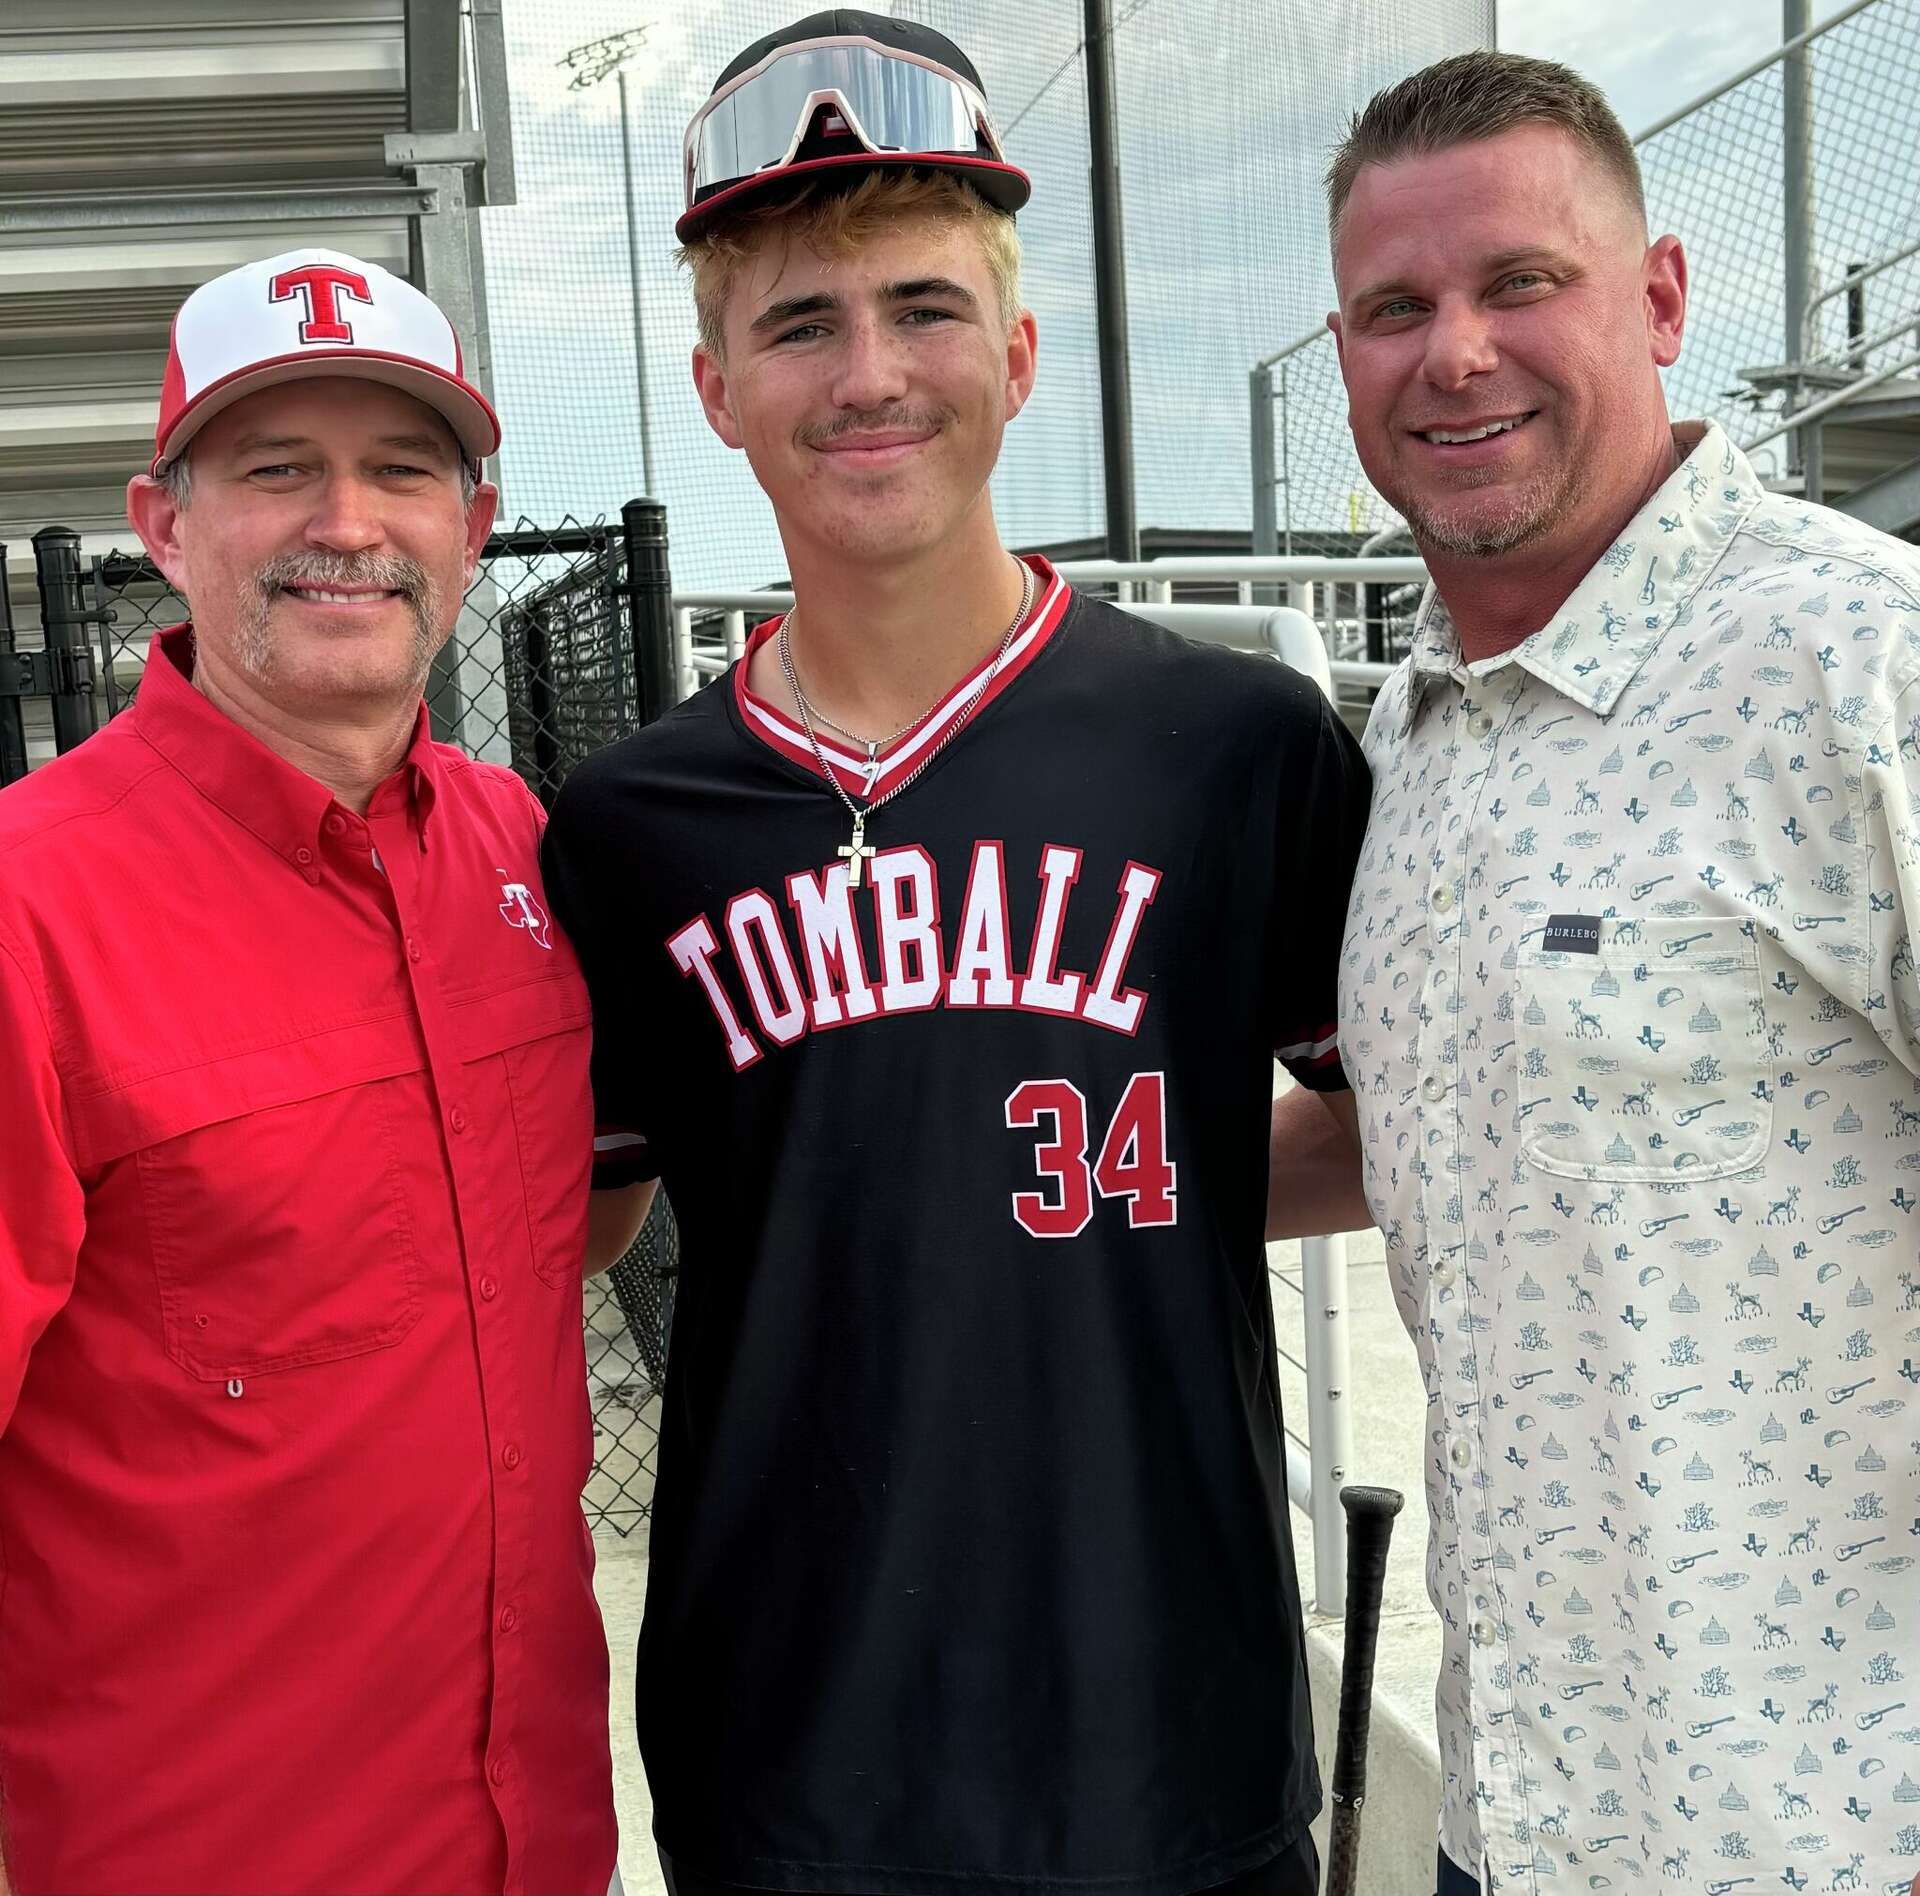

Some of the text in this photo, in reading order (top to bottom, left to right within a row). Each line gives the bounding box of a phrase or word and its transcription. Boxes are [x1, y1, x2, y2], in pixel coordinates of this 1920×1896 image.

[268, 264, 374, 345] T
[665, 839, 1162, 1072] TOMBALL
[1546, 927, 1598, 939] BURLEBO
[1005, 1071, 1176, 1238] 34
